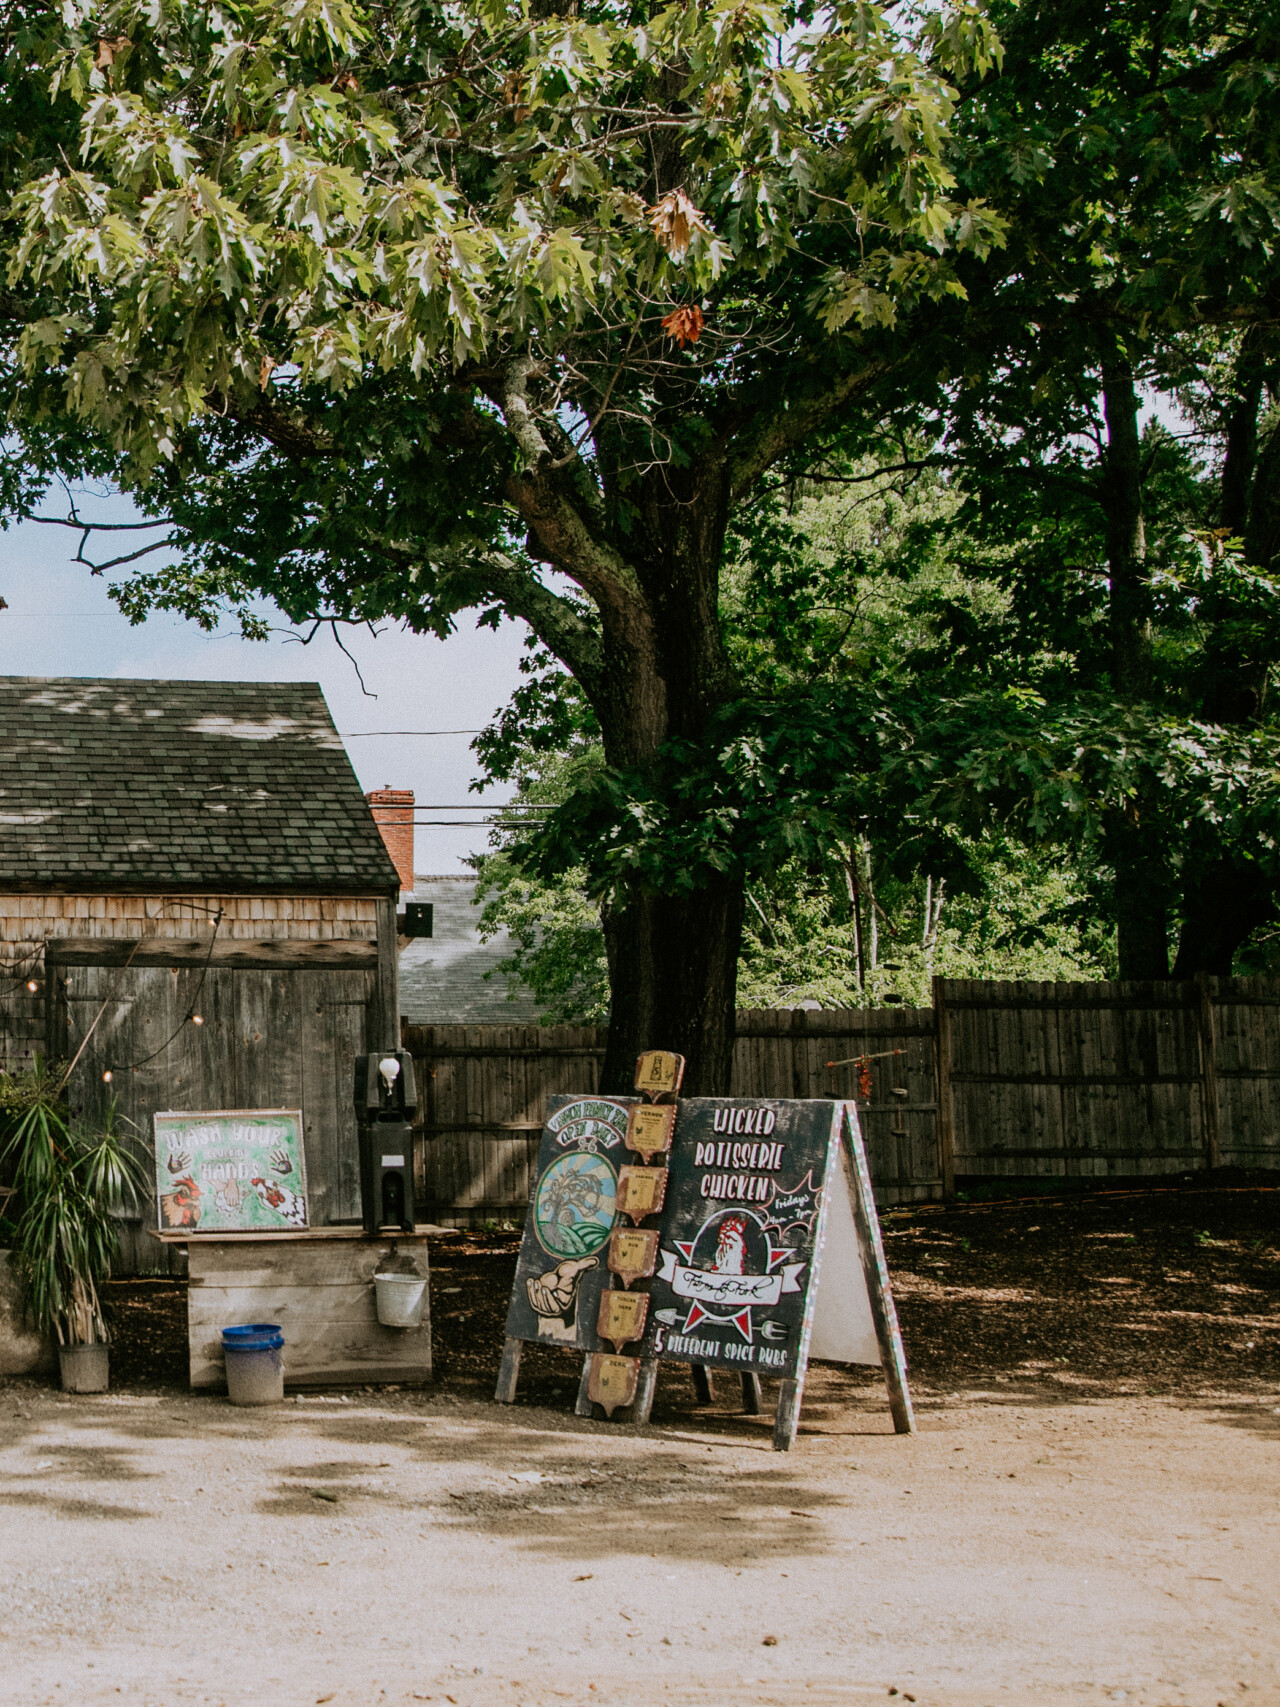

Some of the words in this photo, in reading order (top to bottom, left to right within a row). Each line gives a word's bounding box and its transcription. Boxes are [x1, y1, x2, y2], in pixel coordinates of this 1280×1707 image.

[561, 1121, 587, 1144] OPEN
[713, 1107, 776, 1136] WICKED
[164, 1123, 223, 1152] WASH
[231, 1123, 282, 1147] YOUR
[694, 1141, 785, 1170] ROTISSERIE
[200, 1160, 261, 1180] HANDS
[700, 1174, 770, 1201] CHICKEN
[775, 1194, 810, 1209] Fridays
[794, 1208, 813, 1219] 7pm
[654, 1328, 664, 1352] 5
[667, 1335, 720, 1356] DIFFERENT
[724, 1342, 755, 1361] SPICE
[758, 1346, 787, 1366] RUBS
